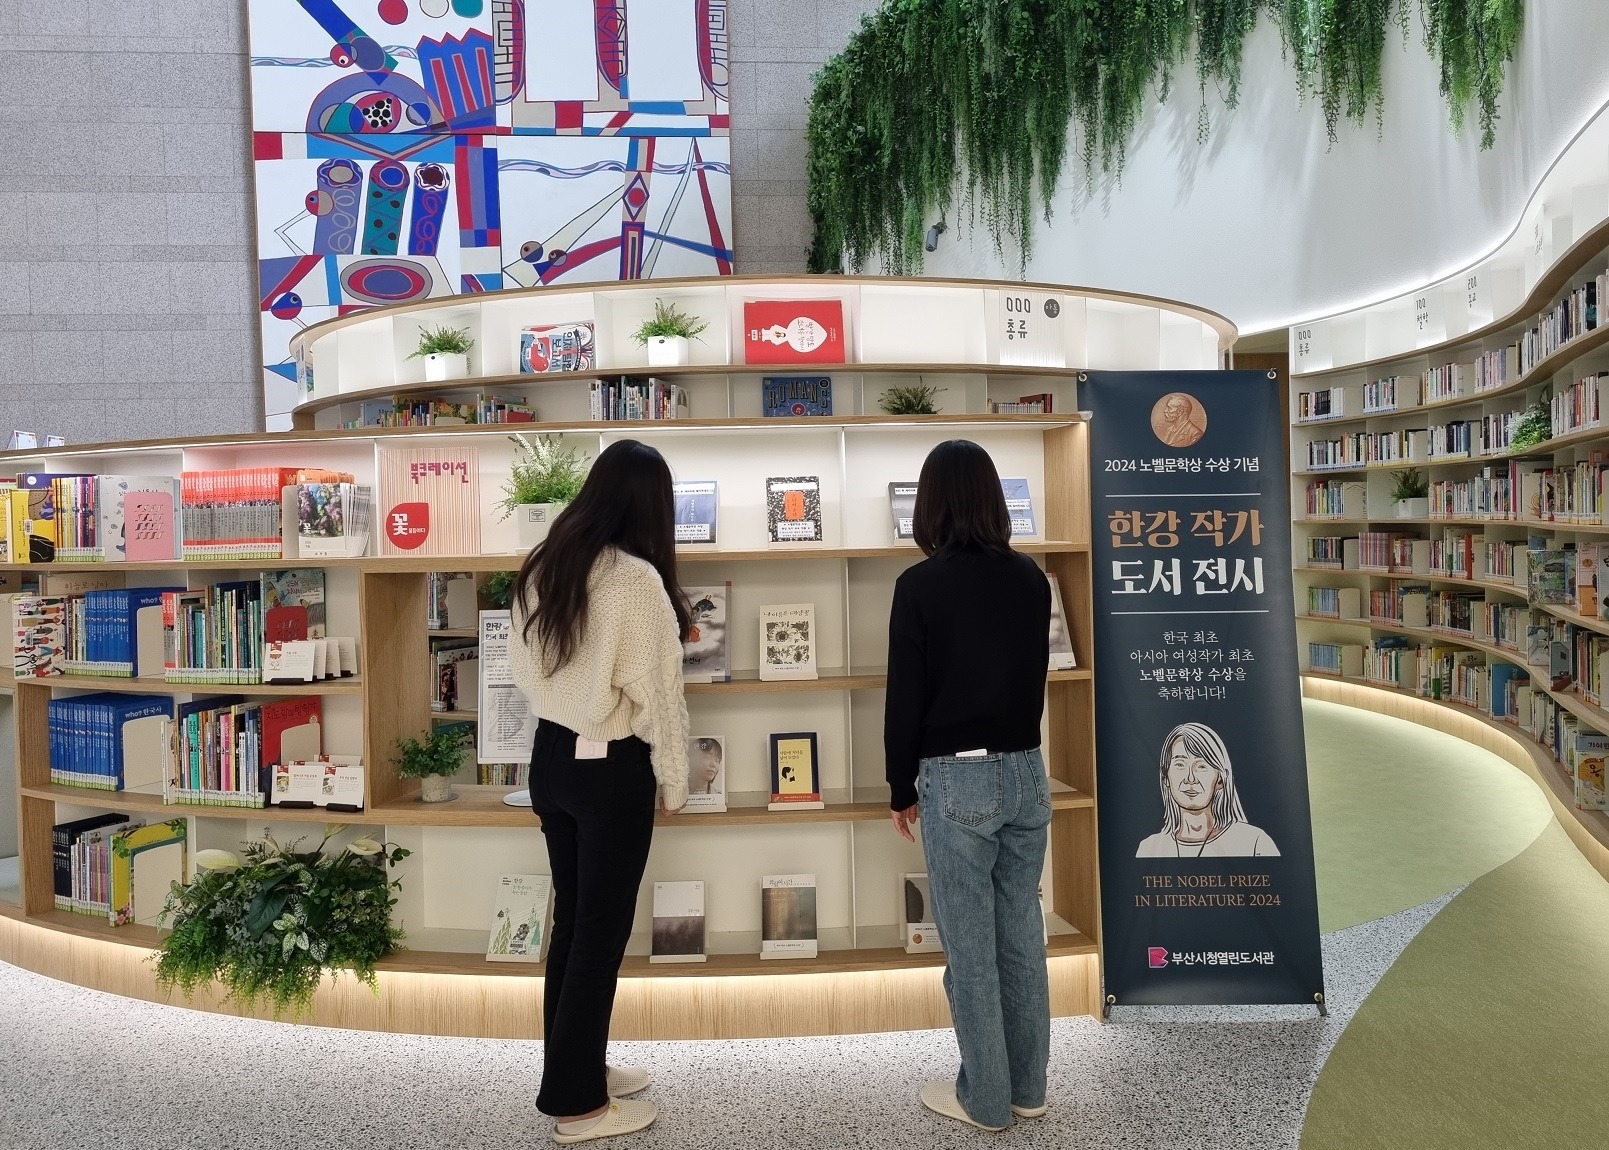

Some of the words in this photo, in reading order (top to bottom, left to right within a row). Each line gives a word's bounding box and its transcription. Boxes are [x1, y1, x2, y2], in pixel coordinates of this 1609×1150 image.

[1467, 276, 1478, 290] 200
[1006, 296, 1031, 313] 000
[1416, 298, 1426, 310] 100
[1468, 292, 1477, 308] 종교
[1045, 303, 1058, 315] 아동
[1416, 312, 1428, 330] 철학
[1006, 318, 1028, 340] 총류
[1298, 330, 1312, 340] 000
[552, 338, 562, 368] 보고서
[1298, 342, 1310, 356] 총류
[768, 380, 828, 408] ROMANS
[1104, 459, 1137, 472] 2024
[1140, 457, 1202, 472] 노벨문학상
[1205, 457, 1230, 472] 수상
[1234, 456, 1260, 472] 기념
[392, 514, 408, 536] 꽃
[1108, 510, 1182, 548] 한강
[1190, 509, 1264, 548] 작가
[1111, 557, 1182, 596] 도서
[1192, 557, 1266, 595] 전시
[486, 622, 502, 632] 한강
[1163, 630, 1189, 644] 한국
[1193, 630, 1219, 644] 최초
[1130, 649, 1168, 662] 아시아
[1172, 648, 1224, 664] 여성작가
[1228, 648, 1254, 662] 최초
[1140, 668, 1203, 682] 노벨문학상
[1208, 666, 1247, 682] 수상을
[1158, 686, 1226, 700] 축하합니다!
[143, 706, 162, 716] 한국사
[1142, 876, 1172, 888] THE
[1177, 875, 1226, 888] NOBEL
[1229, 874, 1270, 888] PRIZE
[1134, 894, 1150, 908] IN
[1156, 894, 1245, 907] LITERATURE
[1249, 894, 1282, 906] 2024
[1172, 952, 1274, 965] 부산시청열린도서관
